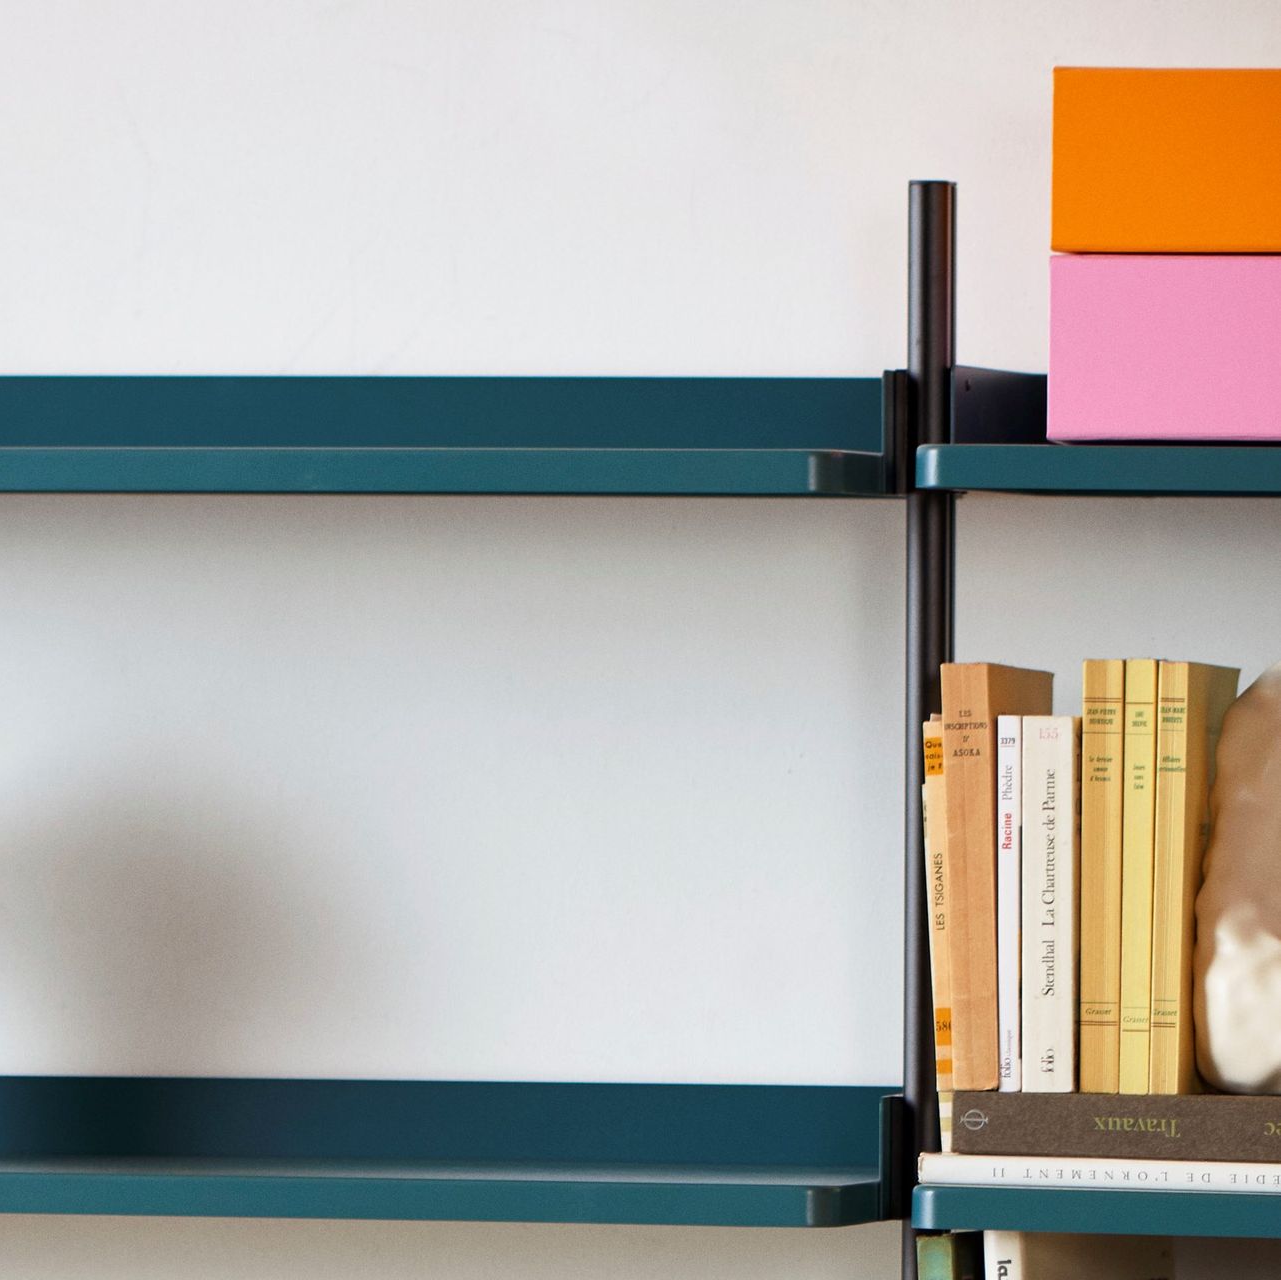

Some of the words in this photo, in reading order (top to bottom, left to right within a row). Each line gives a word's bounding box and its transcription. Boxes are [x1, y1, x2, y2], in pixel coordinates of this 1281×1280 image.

[1041, 768, 1056, 811] Parme
[1002, 812, 1013, 850] Racine
[1042, 815, 1056, 831] de
[933, 852, 945, 907] TSIGANES
[1041, 834, 1056, 905] Chartreuse
[935, 914, 946, 932] LES
[1041, 910, 1056, 927] La
[1041, 940, 1056, 997] Stendhal
[1041, 1047, 1055, 1074] folio
[1094, 1116, 1181, 1138] Travaux
[1023, 1168, 1169, 1183] L'ORNEMENT
[1186, 1173, 1212, 1184] DE
